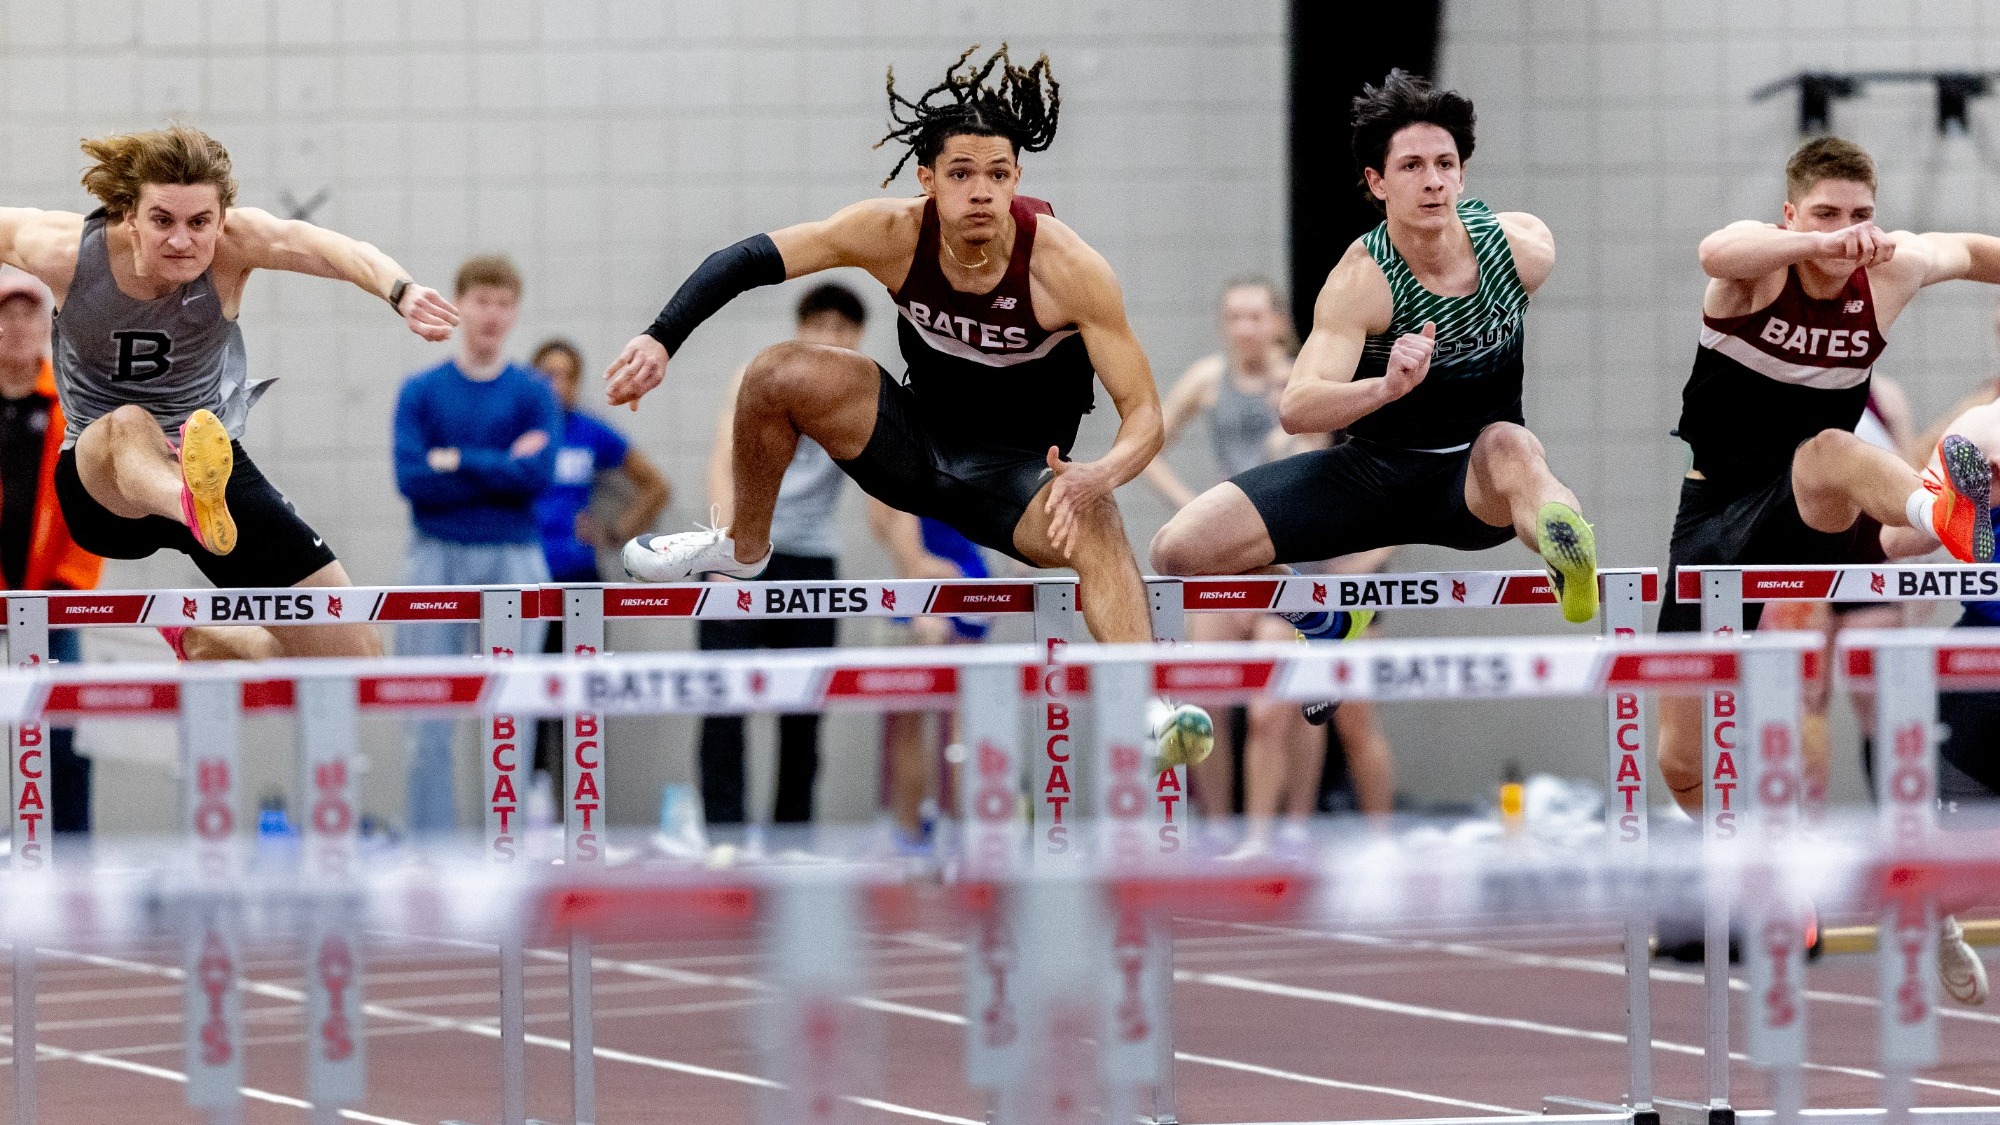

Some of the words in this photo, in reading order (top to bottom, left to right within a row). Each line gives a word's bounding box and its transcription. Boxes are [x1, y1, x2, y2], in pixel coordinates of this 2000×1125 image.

[909, 300, 1029, 349] BATES
[1760, 316, 1870, 358] BATES
[111, 329, 174, 383] B
[1340, 580, 1439, 607] BATES
[1898, 570, 1998, 596] BATES
[211, 595, 314, 621] BATES
[765, 587, 868, 614] BATES
